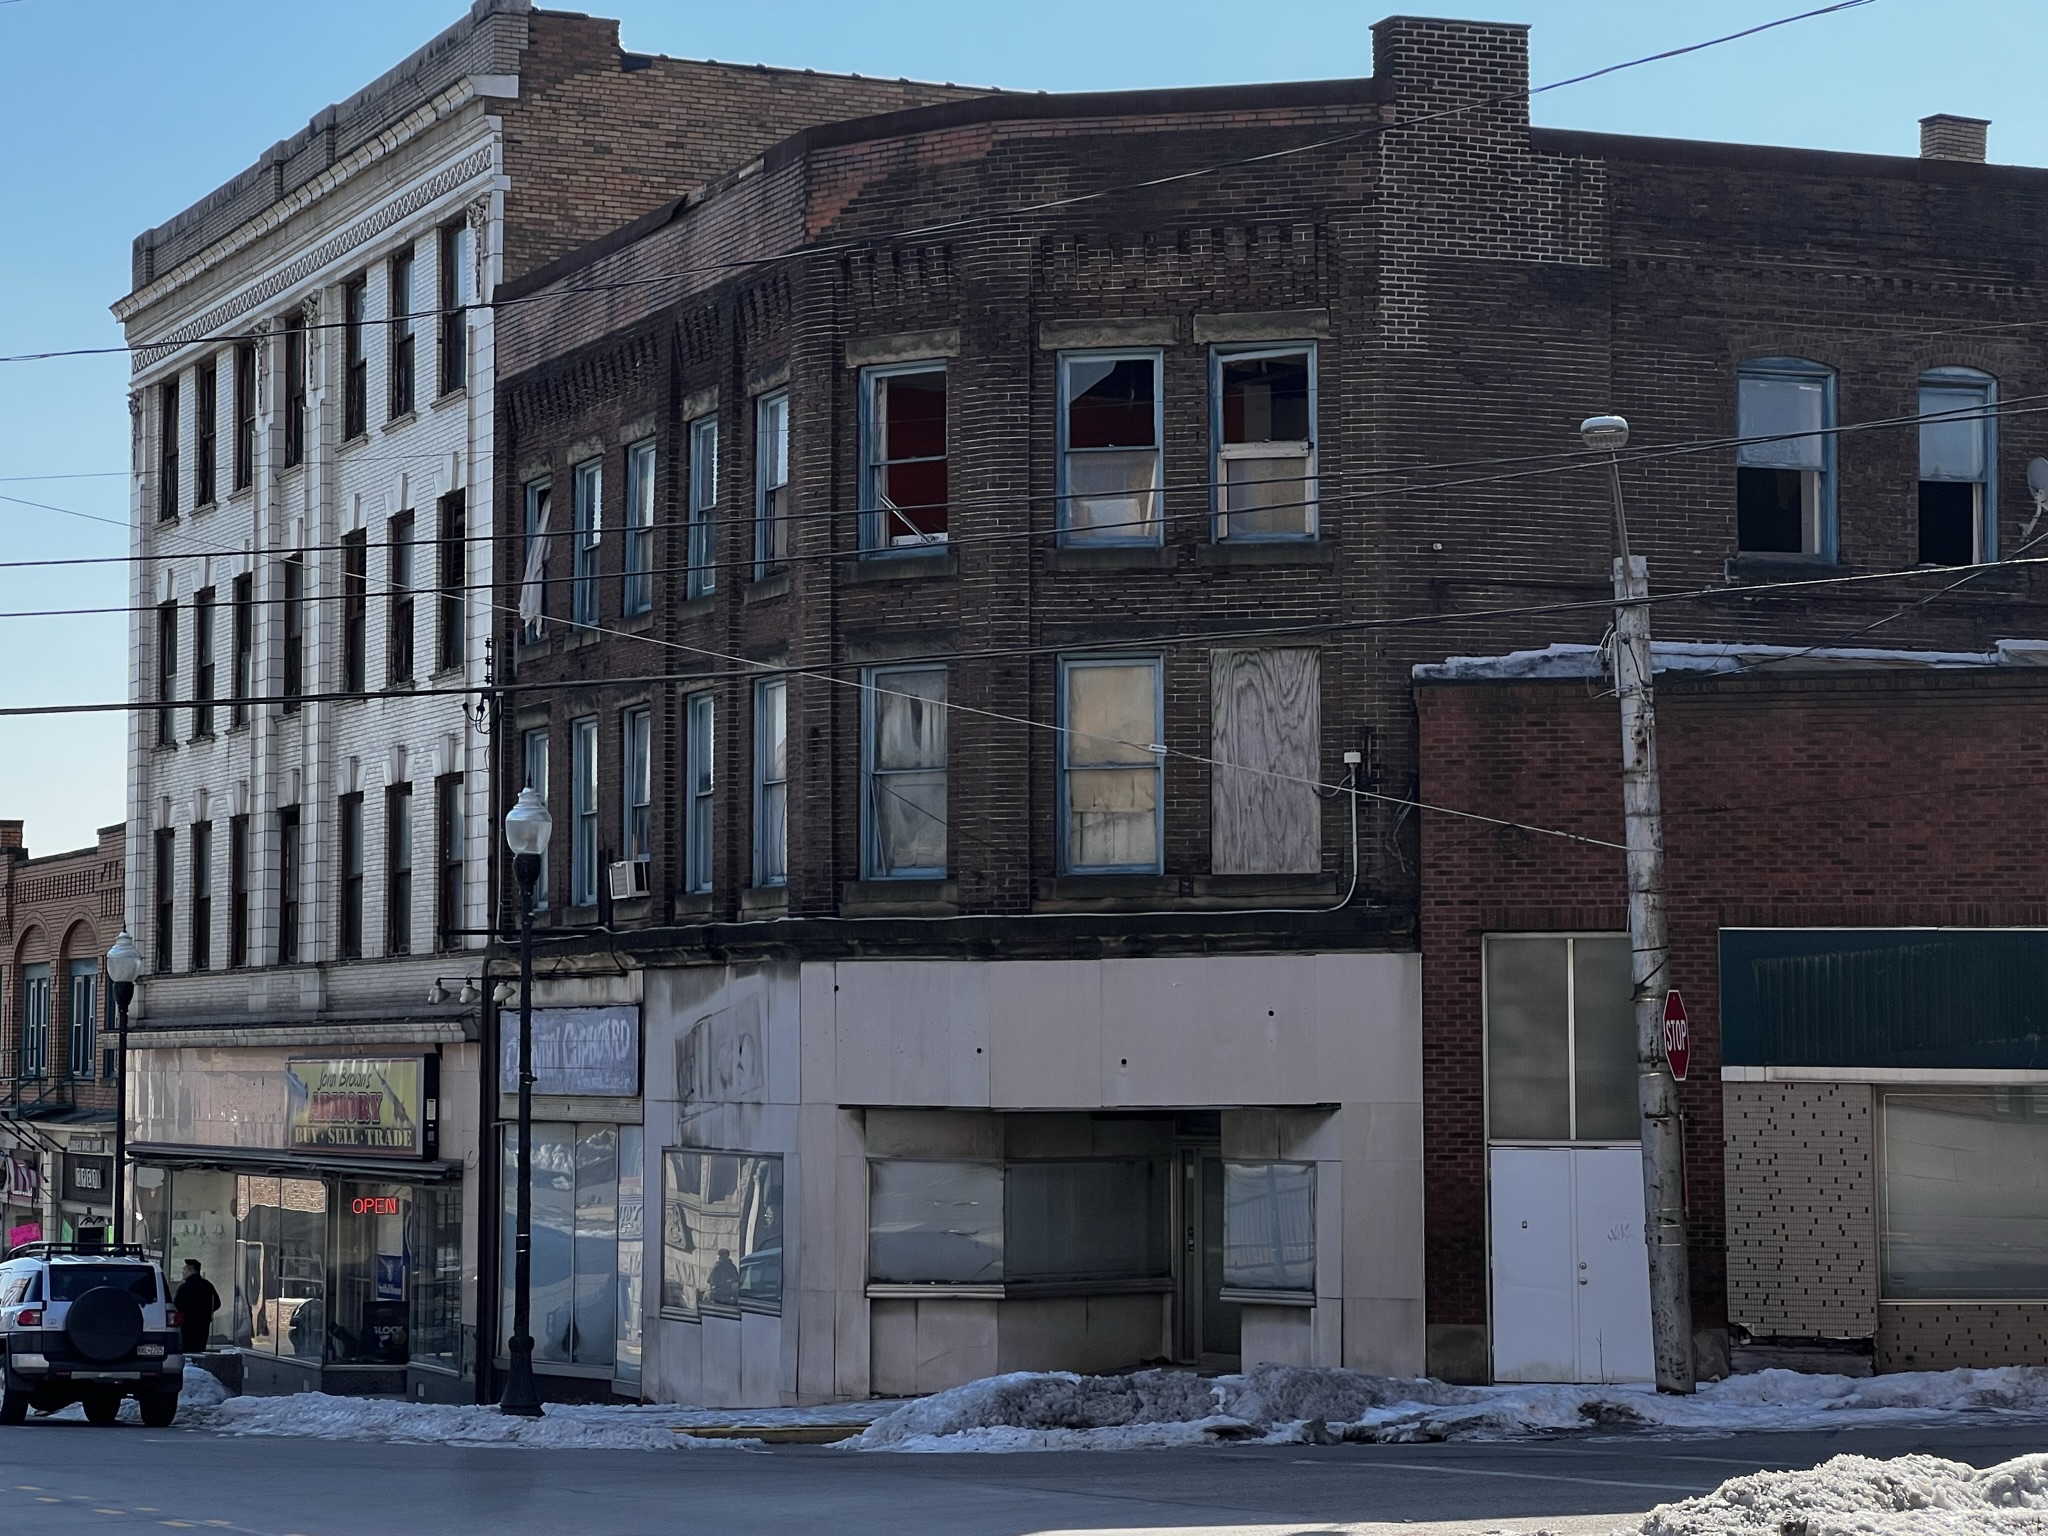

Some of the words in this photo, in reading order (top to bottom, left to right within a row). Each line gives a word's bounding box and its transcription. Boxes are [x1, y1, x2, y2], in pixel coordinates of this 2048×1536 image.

[1666, 1020, 1687, 1052] STOP
[505, 1026, 561, 1084] CNTRY
[317, 1066, 337, 1091] John
[338, 1067, 373, 1090] Brown's
[308, 1091, 384, 1125] ARMORY
[295, 1126, 319, 1144] BUY
[327, 1126, 359, 1146] SELL
[365, 1128, 412, 1147] TRADE
[352, 1198, 397, 1215] OPEN
[373, 1326, 404, 1335] LOCK
